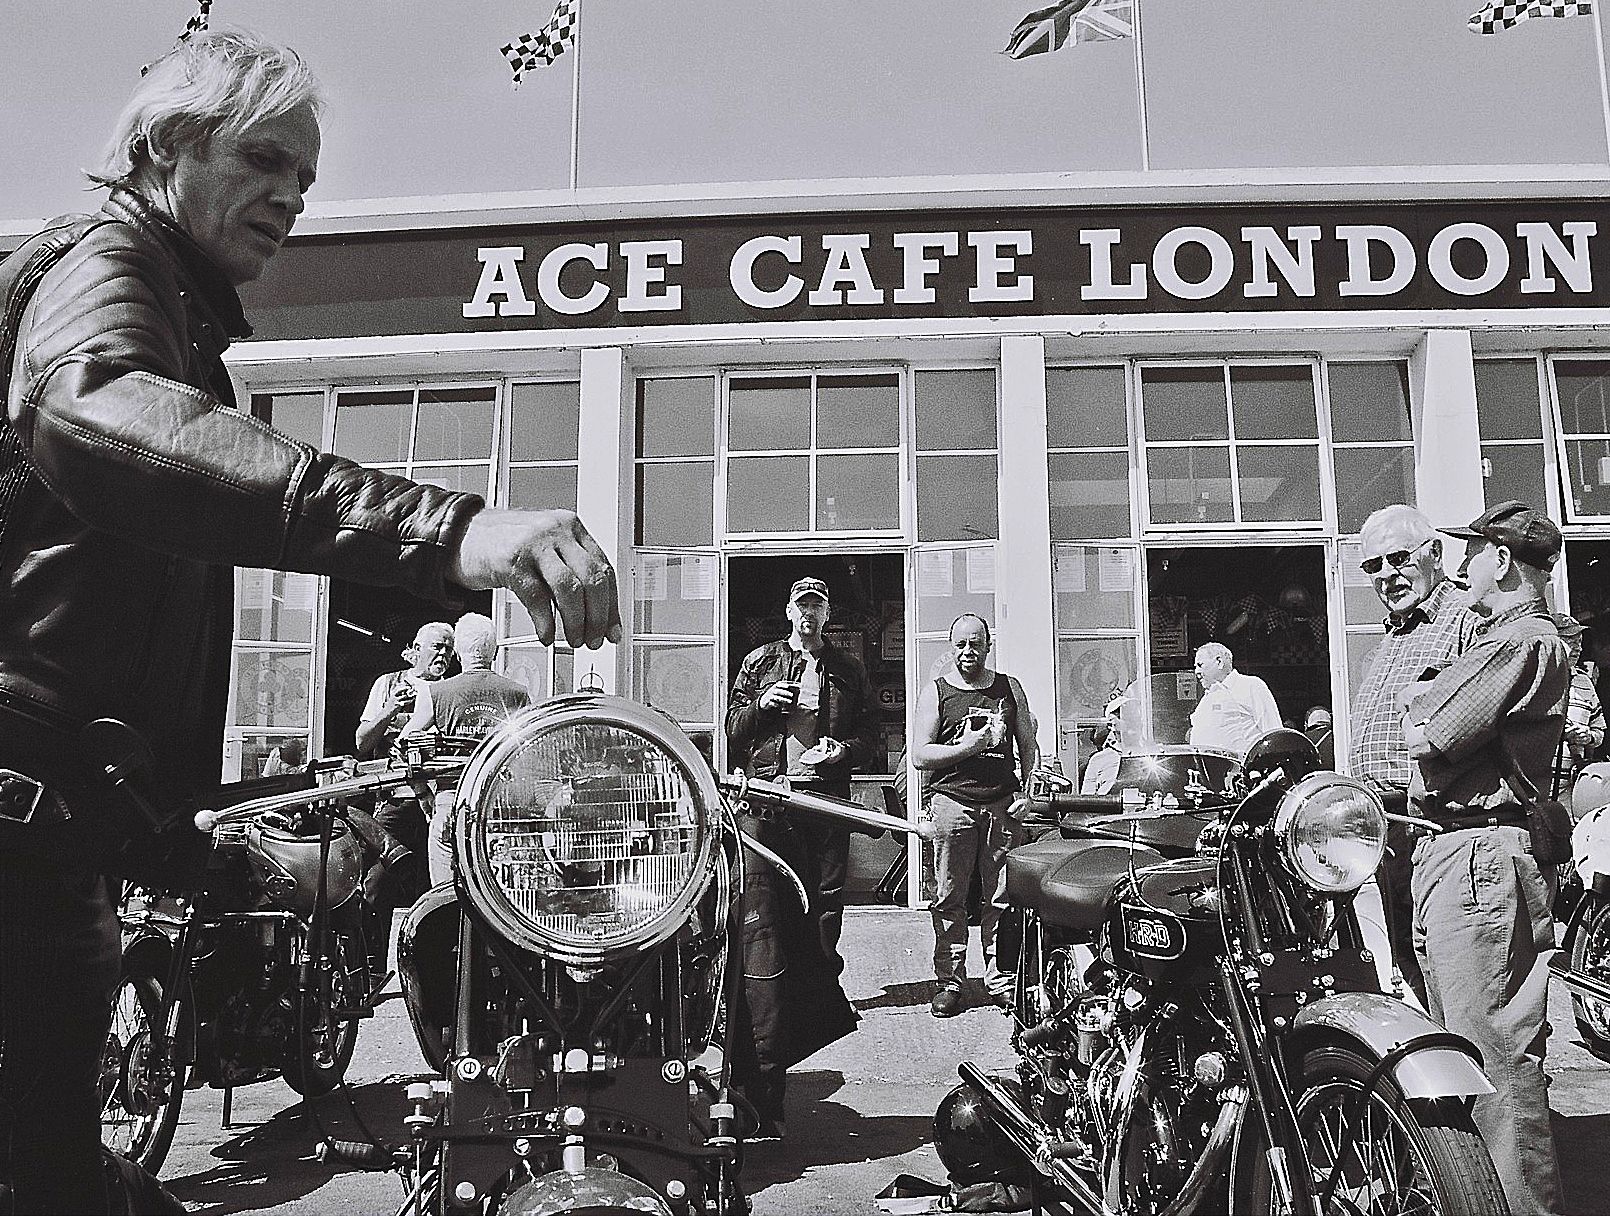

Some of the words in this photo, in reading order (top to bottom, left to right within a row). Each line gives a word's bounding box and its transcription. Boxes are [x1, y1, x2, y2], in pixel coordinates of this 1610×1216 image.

[463, 240, 682, 317] ACE
[730, 231, 1033, 308] CAFE
[1080, 222, 1597, 300] LONDON
[465, 705, 498, 715] GENUINE
